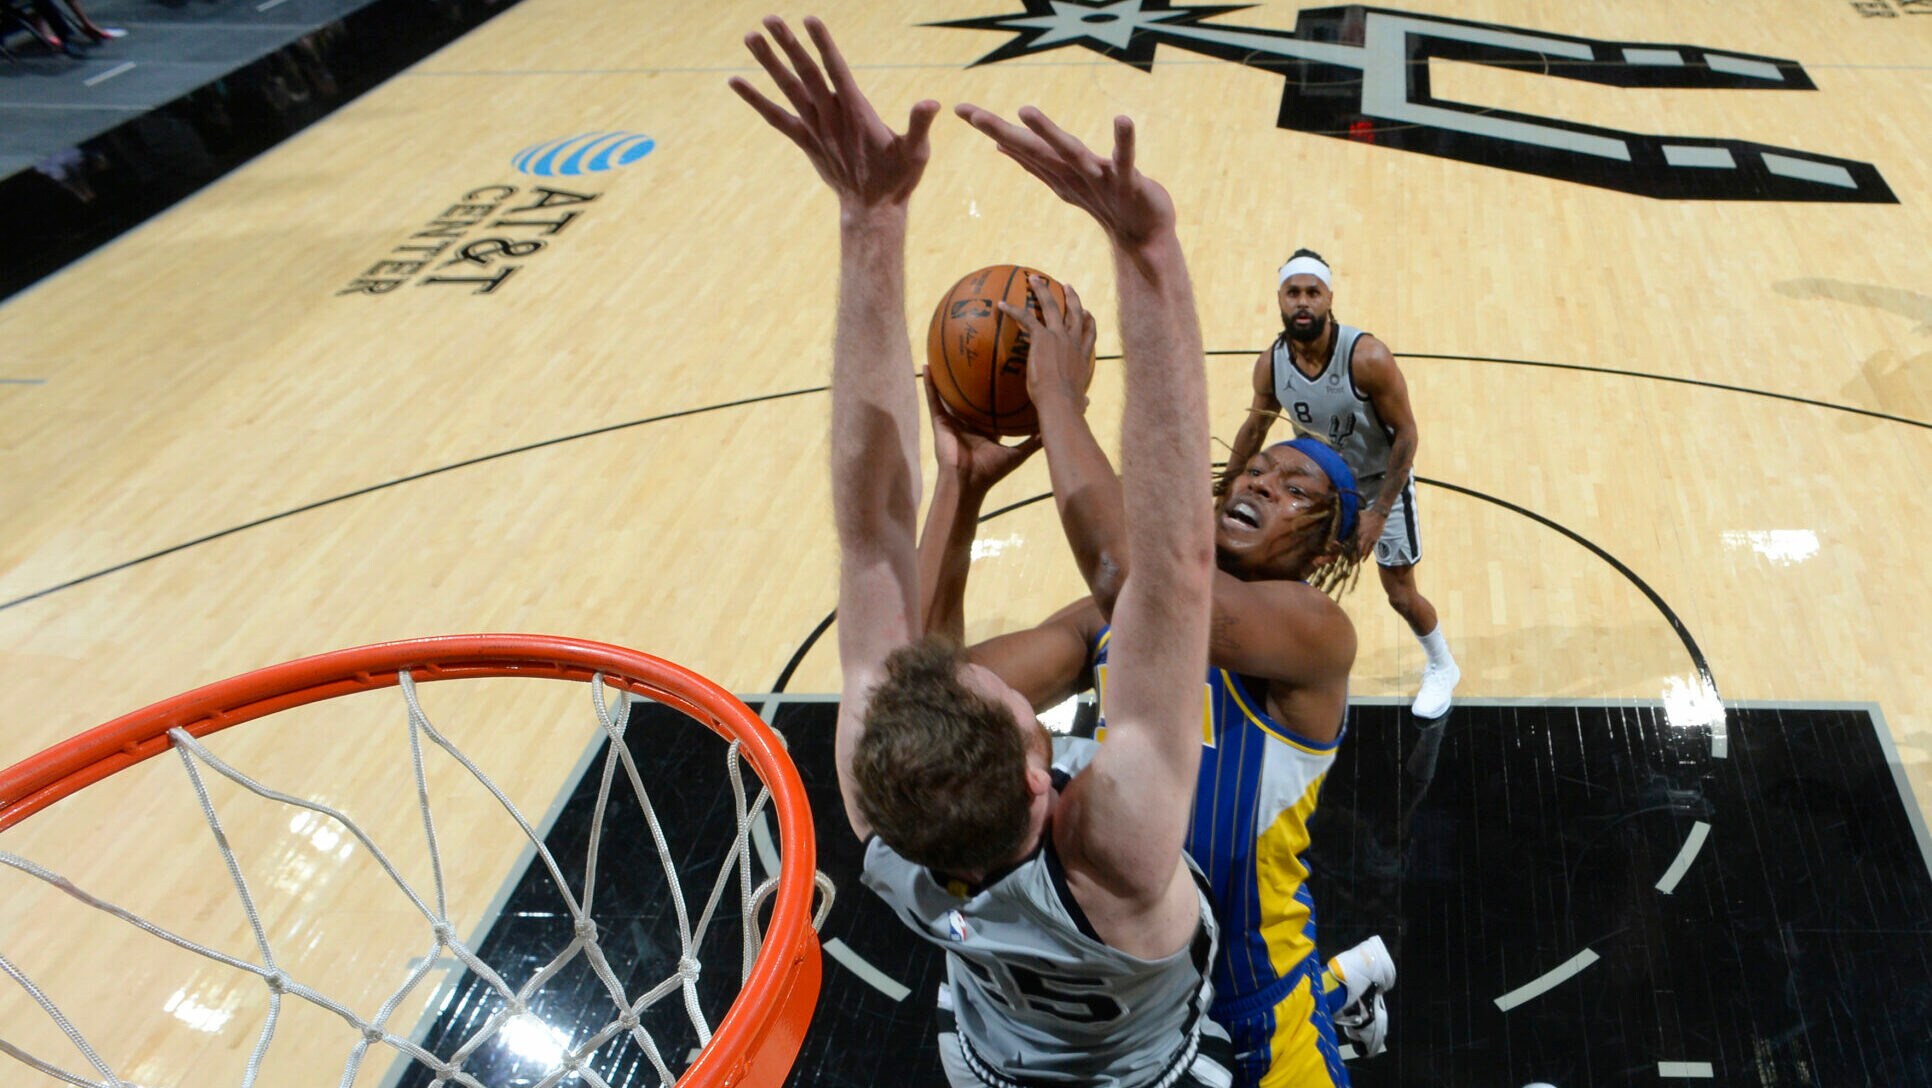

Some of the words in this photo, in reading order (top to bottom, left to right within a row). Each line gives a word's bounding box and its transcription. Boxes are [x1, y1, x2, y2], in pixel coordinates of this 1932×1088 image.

[334, 184, 519, 296] CENTER
[415, 185, 605, 295] AT&T
[1294, 402, 1313, 423] 8
